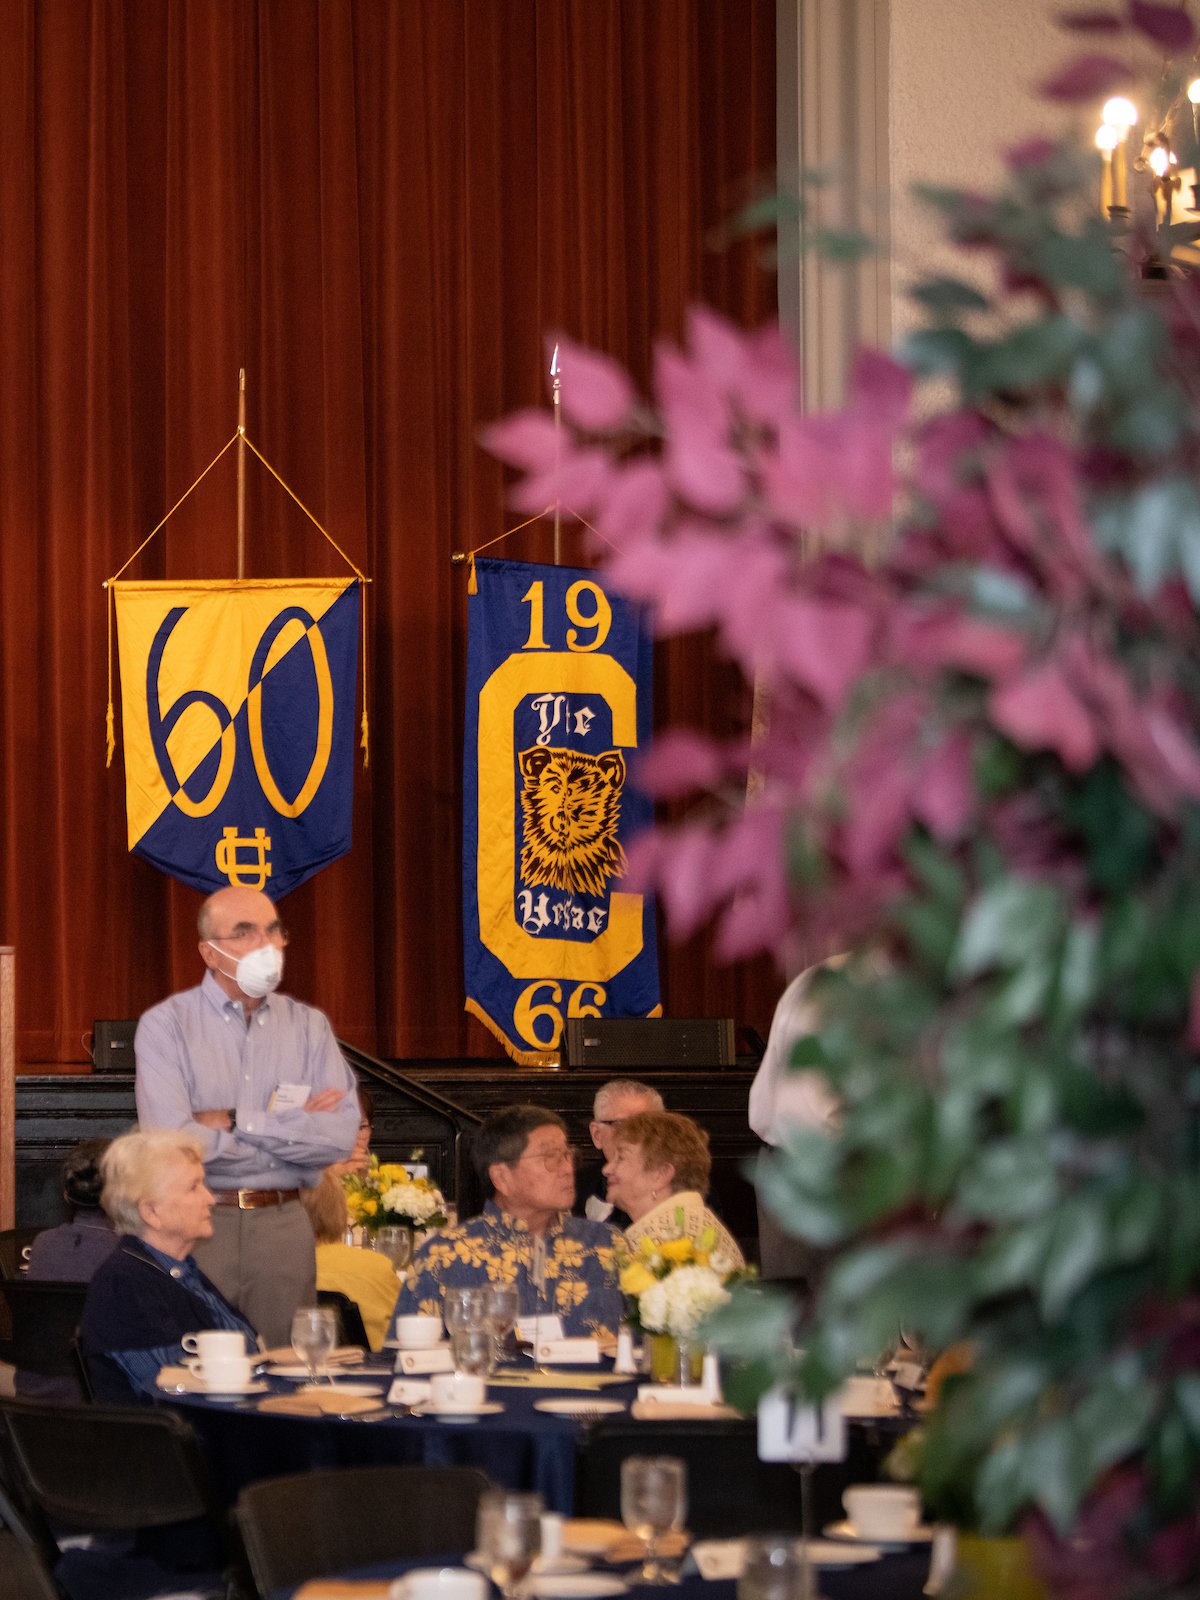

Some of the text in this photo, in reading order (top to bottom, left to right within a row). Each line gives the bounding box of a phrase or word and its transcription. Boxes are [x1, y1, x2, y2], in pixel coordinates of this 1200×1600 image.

[521, 579, 612, 653] 19
[146, 606, 334, 818] 60
[531, 693, 596, 746] Te
[513, 980, 607, 1051] 66
